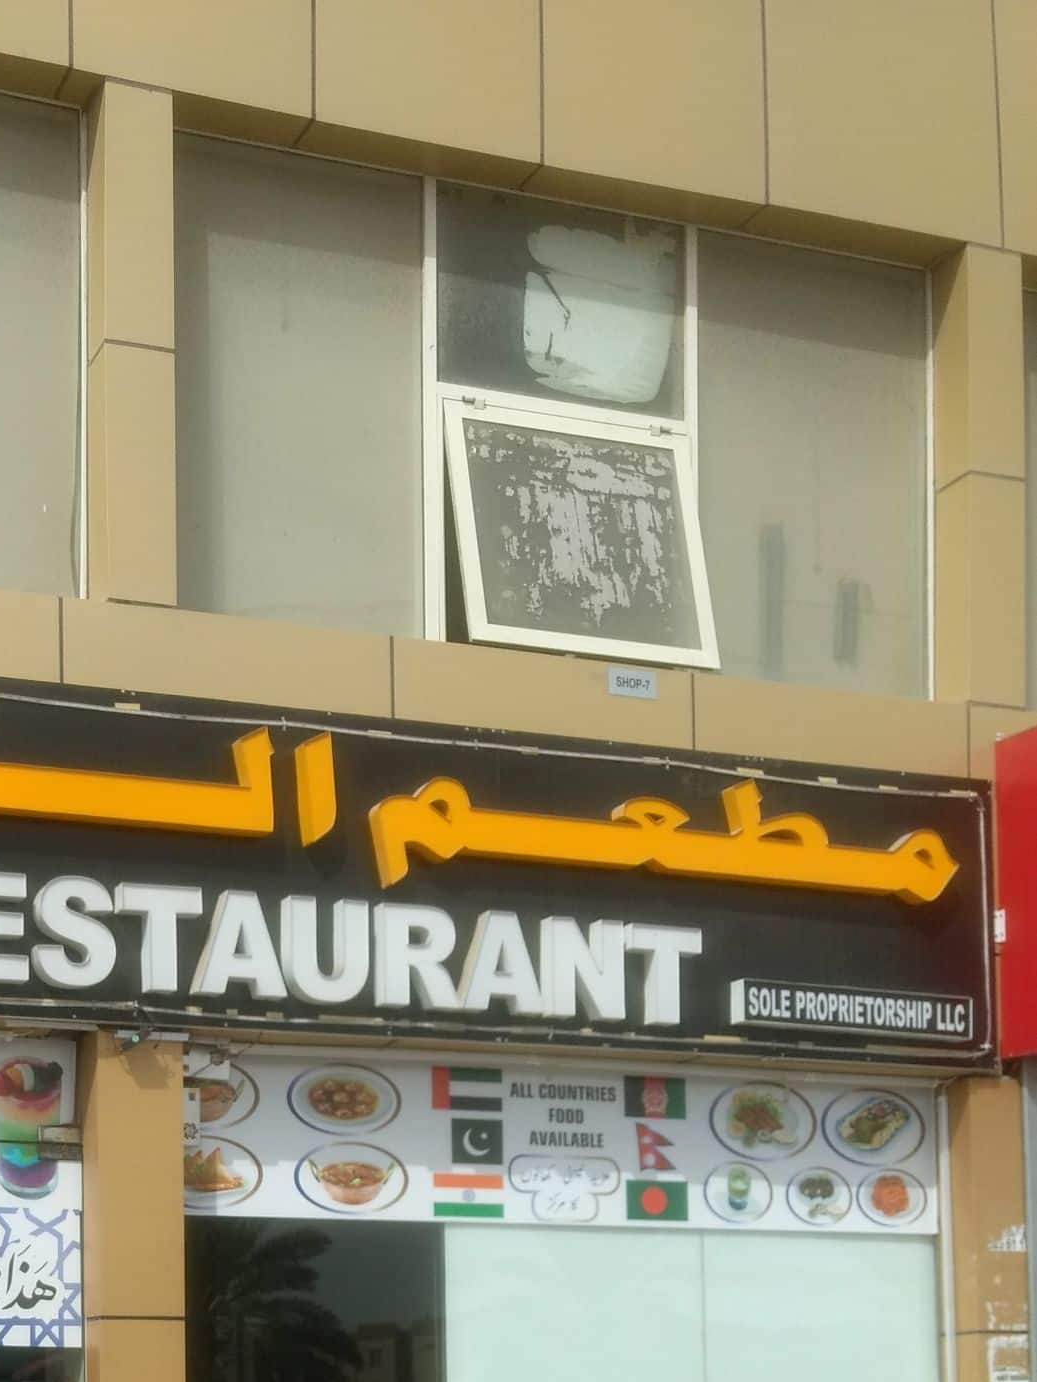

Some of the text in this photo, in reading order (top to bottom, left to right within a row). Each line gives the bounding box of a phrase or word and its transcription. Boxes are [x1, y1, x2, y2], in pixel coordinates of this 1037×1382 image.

[368, 777, 961, 902] مطعم
[748, 986, 965, 1033] SOLE PROPRIETORSHIP LLC
[510, 1082, 617, 1103] ALL COUNTRIES
[548, 1107, 584, 1125] FOOD
[529, 1130, 605, 1149] AVAILABLE
